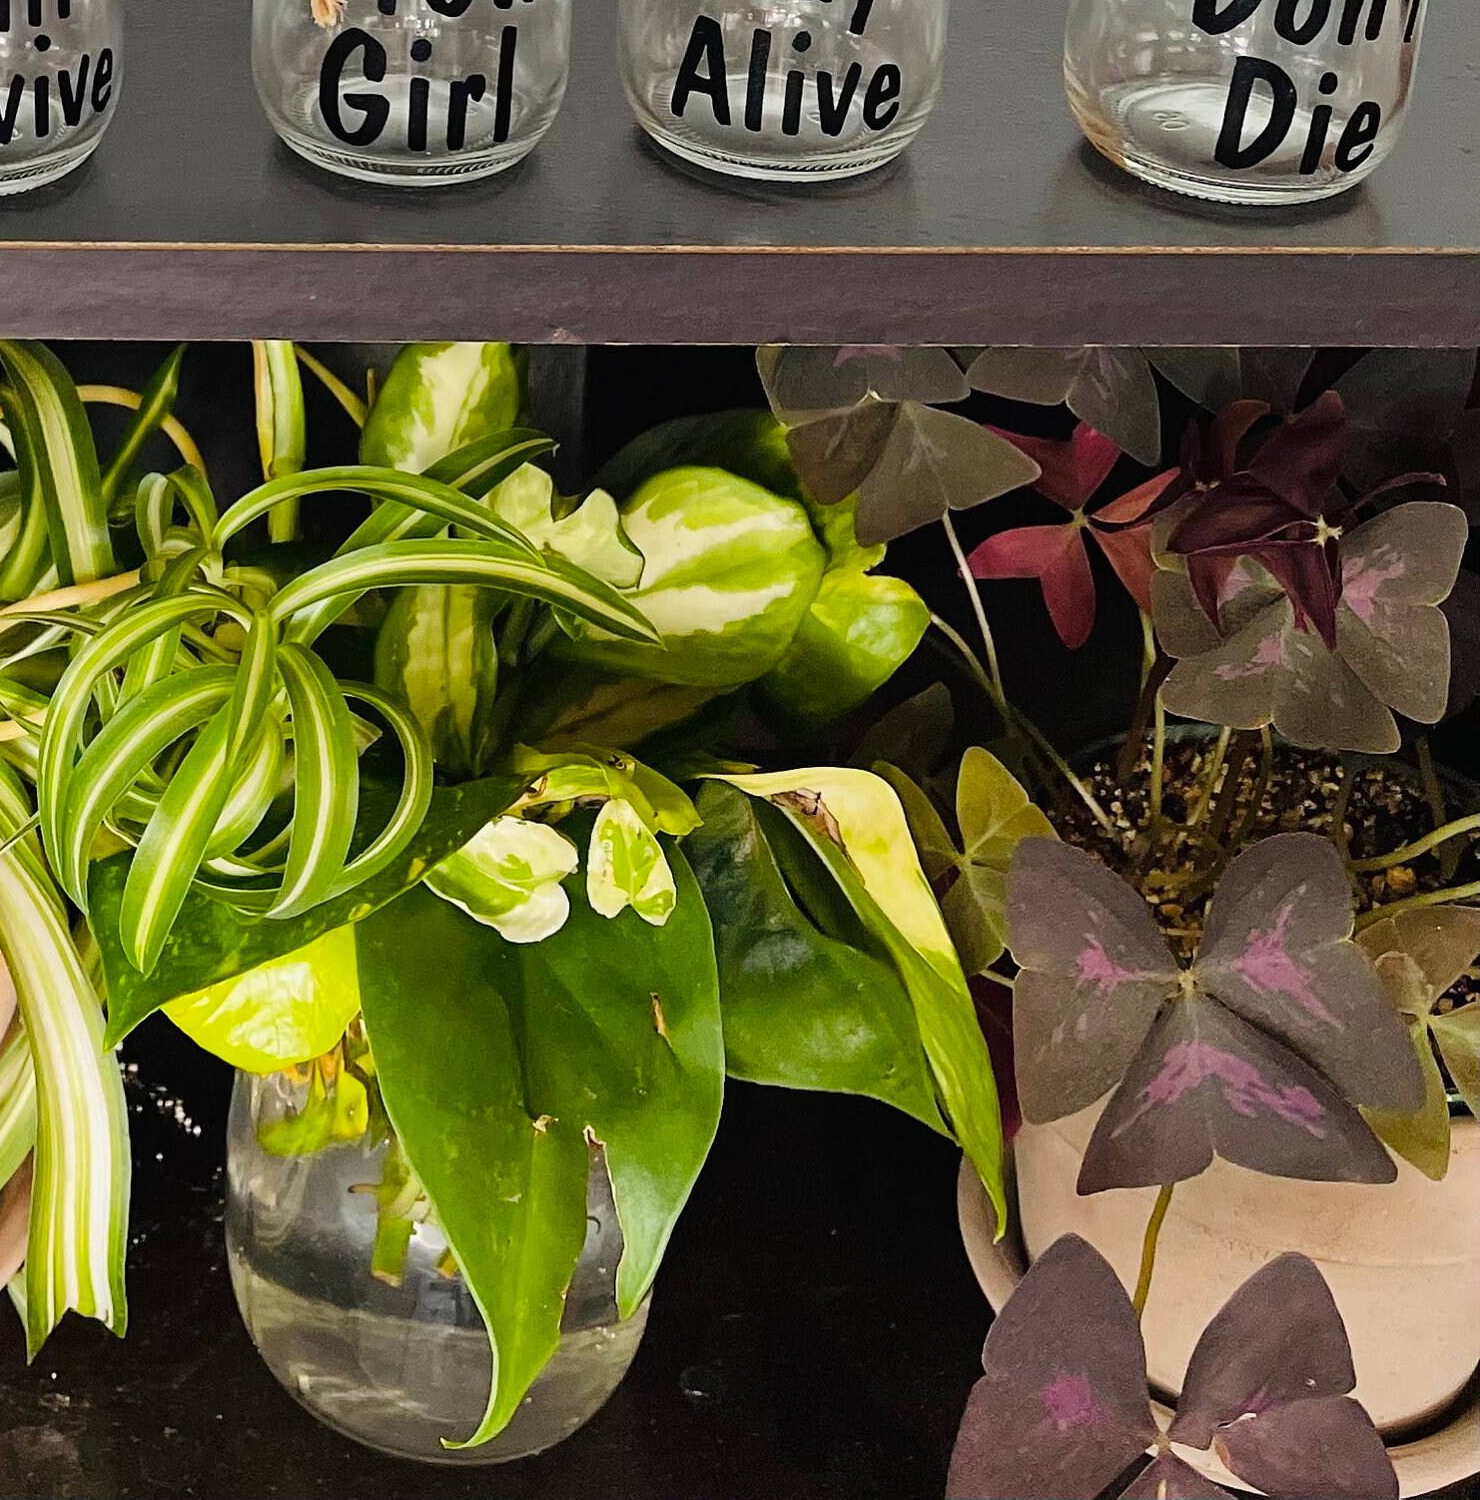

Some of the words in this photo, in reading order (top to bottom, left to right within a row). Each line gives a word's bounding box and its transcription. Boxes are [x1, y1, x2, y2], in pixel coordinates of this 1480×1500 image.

[319, 26, 517, 152] Girl
[670, 15, 901, 137] Alive
[1214, 56, 1381, 175] Die
